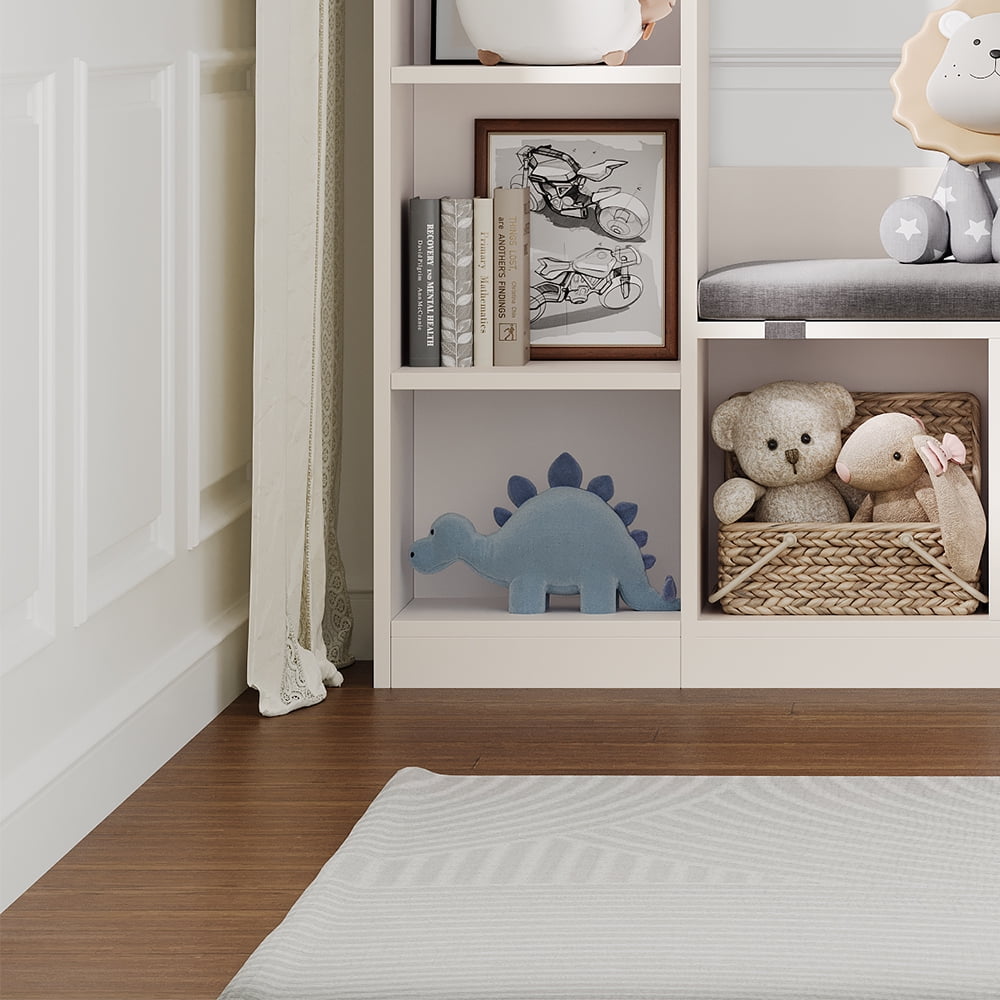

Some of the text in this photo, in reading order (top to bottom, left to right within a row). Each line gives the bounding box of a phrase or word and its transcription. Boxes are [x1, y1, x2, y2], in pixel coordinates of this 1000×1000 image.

[426, 224, 435, 266] RECOVERY
[509, 216, 518, 246] THINGS
[478, 232, 489, 334] Primary Mathematics
[498, 217, 506, 319] are ANOTHER'S FINDINGS
[426, 281, 435, 315] MENTAL
[426, 315, 435, 347] HEALTH
